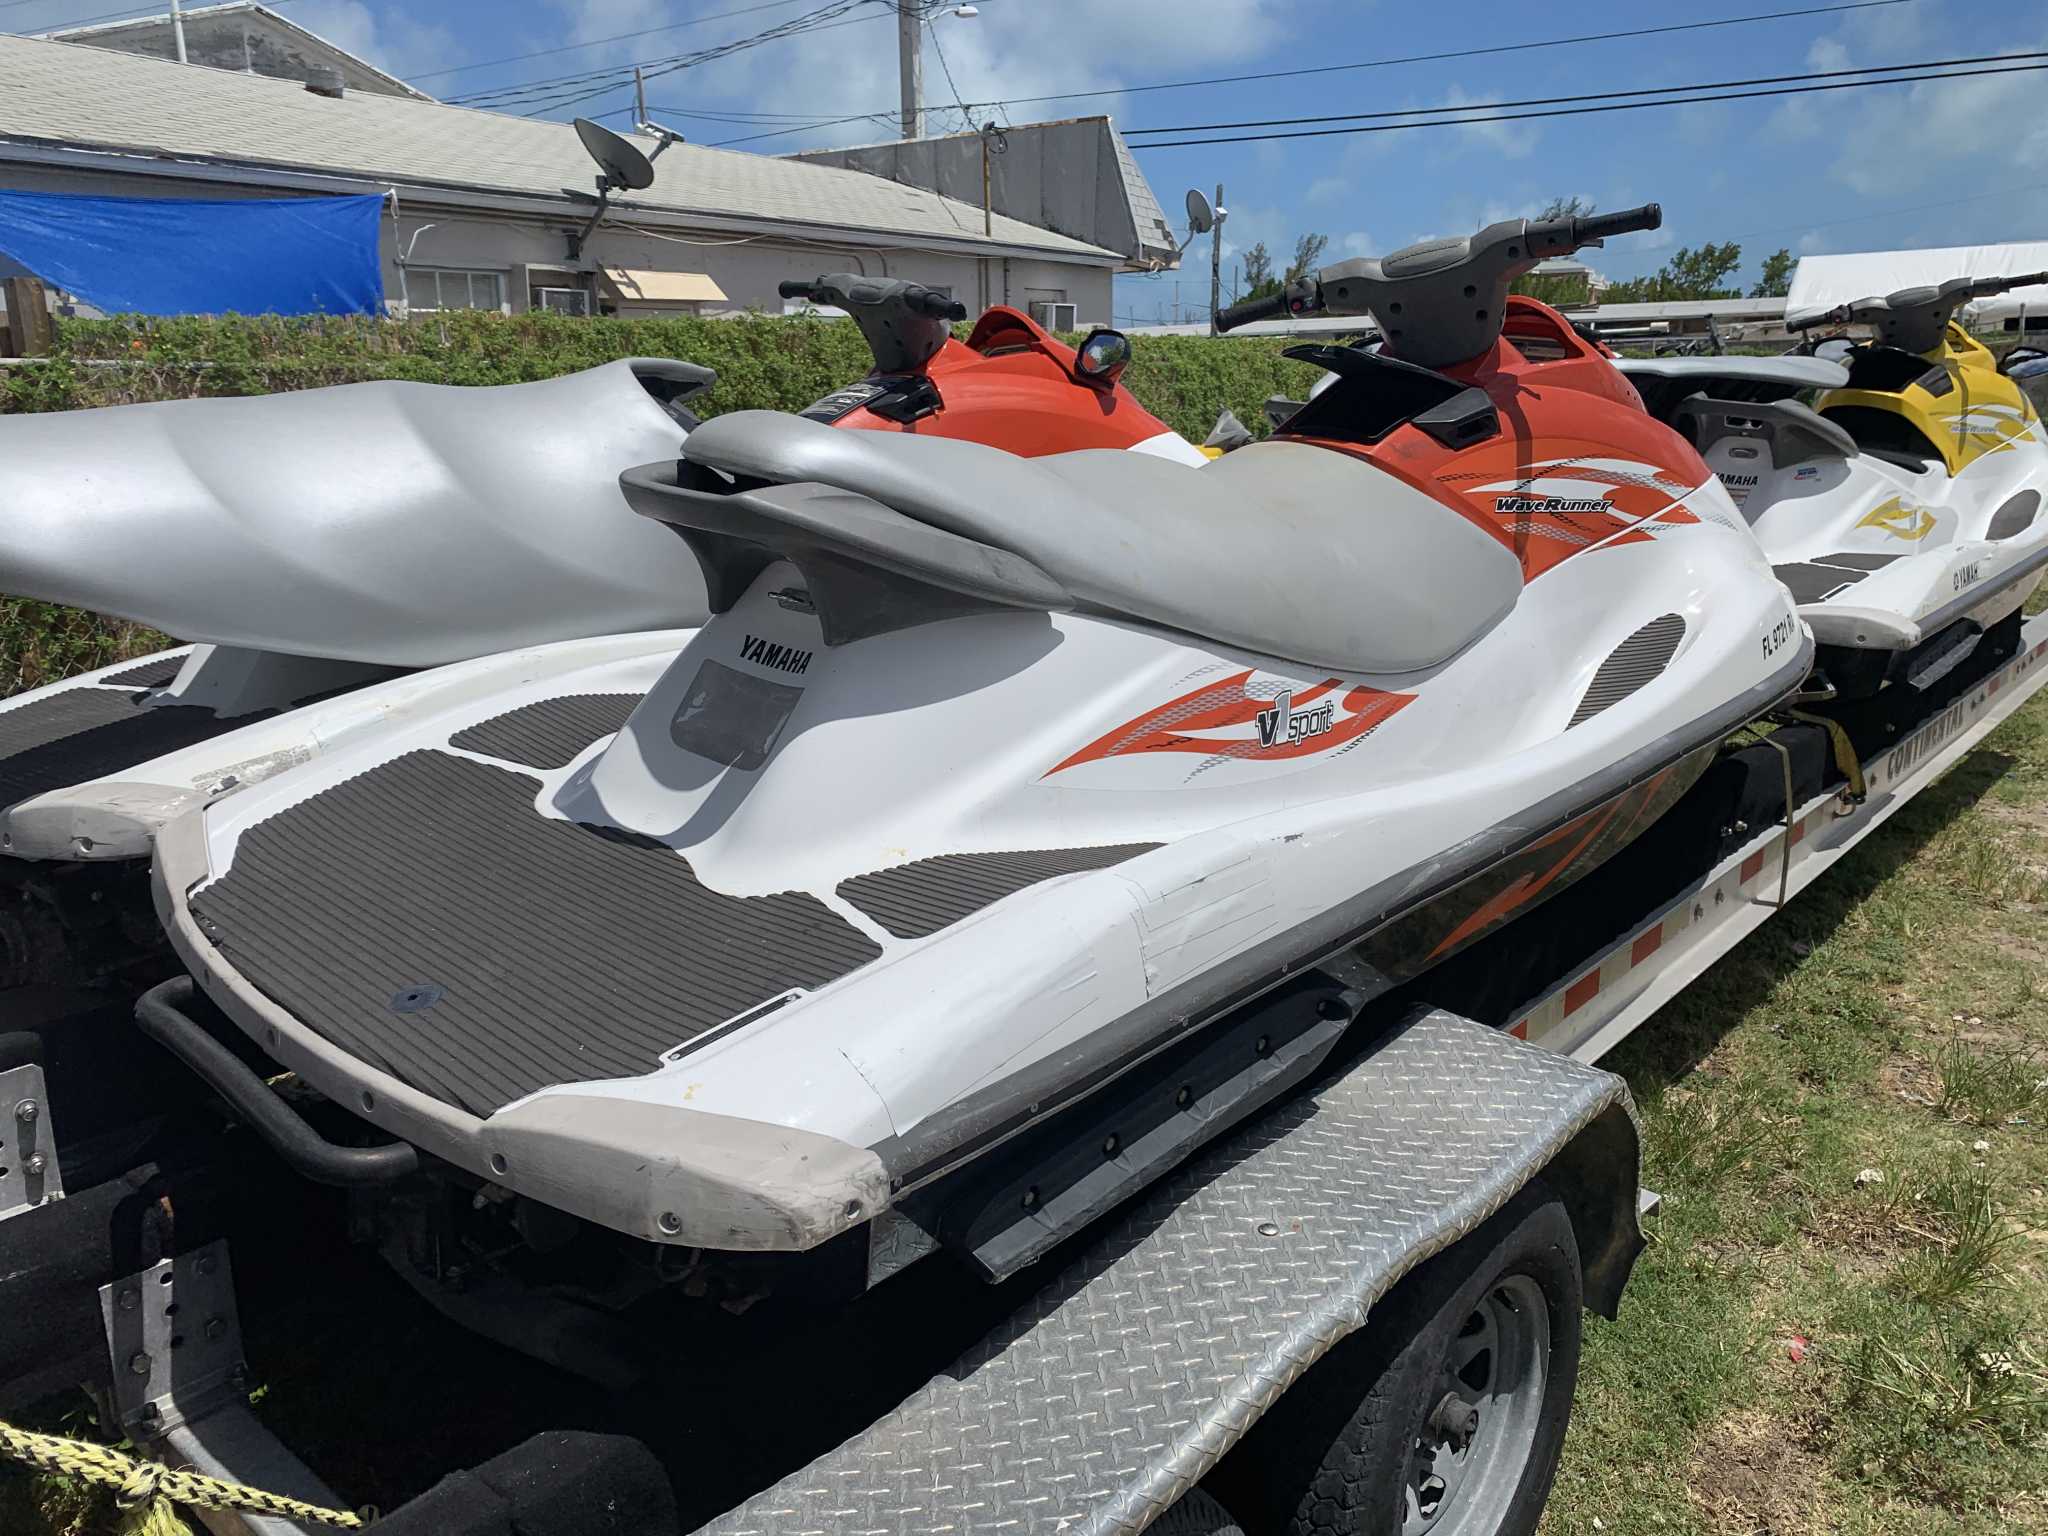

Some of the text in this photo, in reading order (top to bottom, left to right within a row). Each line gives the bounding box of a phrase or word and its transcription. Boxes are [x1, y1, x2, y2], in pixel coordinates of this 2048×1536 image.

[1716, 472, 1759, 486] AMAHA
[1495, 497, 1614, 514] WaveRunner
[739, 635, 813, 675] YAMAHA
[1762, 635, 1773, 660] FL
